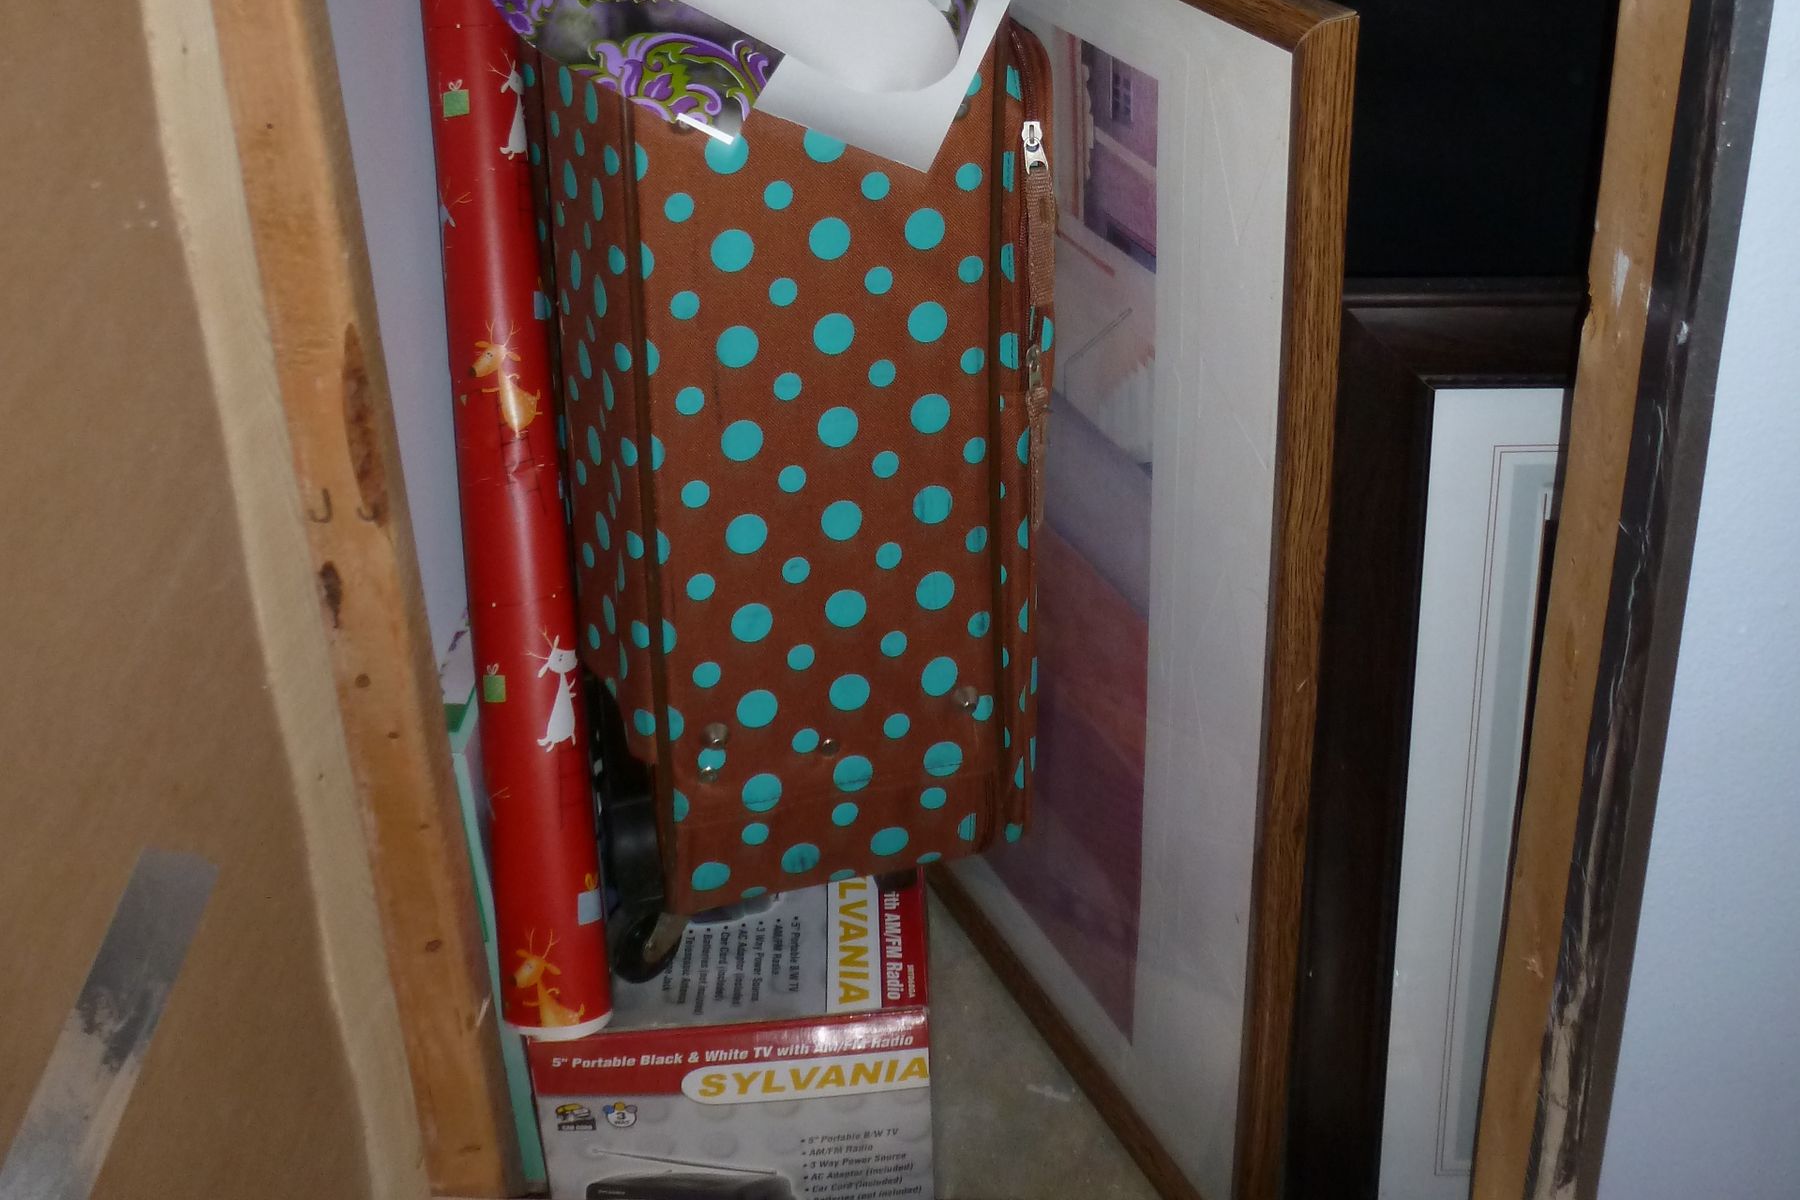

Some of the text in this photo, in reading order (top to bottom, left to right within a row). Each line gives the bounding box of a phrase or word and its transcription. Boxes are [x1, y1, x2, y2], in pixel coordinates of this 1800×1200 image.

[752, 934, 764, 950] Way
[838, 879, 869, 1005] LVANIA
[884, 913, 903, 959] AM/FM
[753, 952, 764, 975] Power
[789, 982, 799, 992] TV
[886, 962, 904, 1000] Radio
[572, 1055, 636, 1068] Portable
[640, 1053, 683, 1066] Black
[688, 1051, 699, 1063] &
[705, 1047, 748, 1062] White
[753, 1046, 773, 1059] TV
[777, 1043, 809, 1056] with
[871, 1035, 914, 1048] Radio
[698, 1056, 929, 1098] SYLVANIA
[616, 1112, 626, 1120] 3
[821, 1133, 860, 1143] Portable
[886, 1128, 899, 1136] TV
[845, 1145, 874, 1154] Radio
[819, 1160, 839, 1169] Way
[842, 1157, 872, 1166] Power
[874, 1153, 907, 1163] Source
